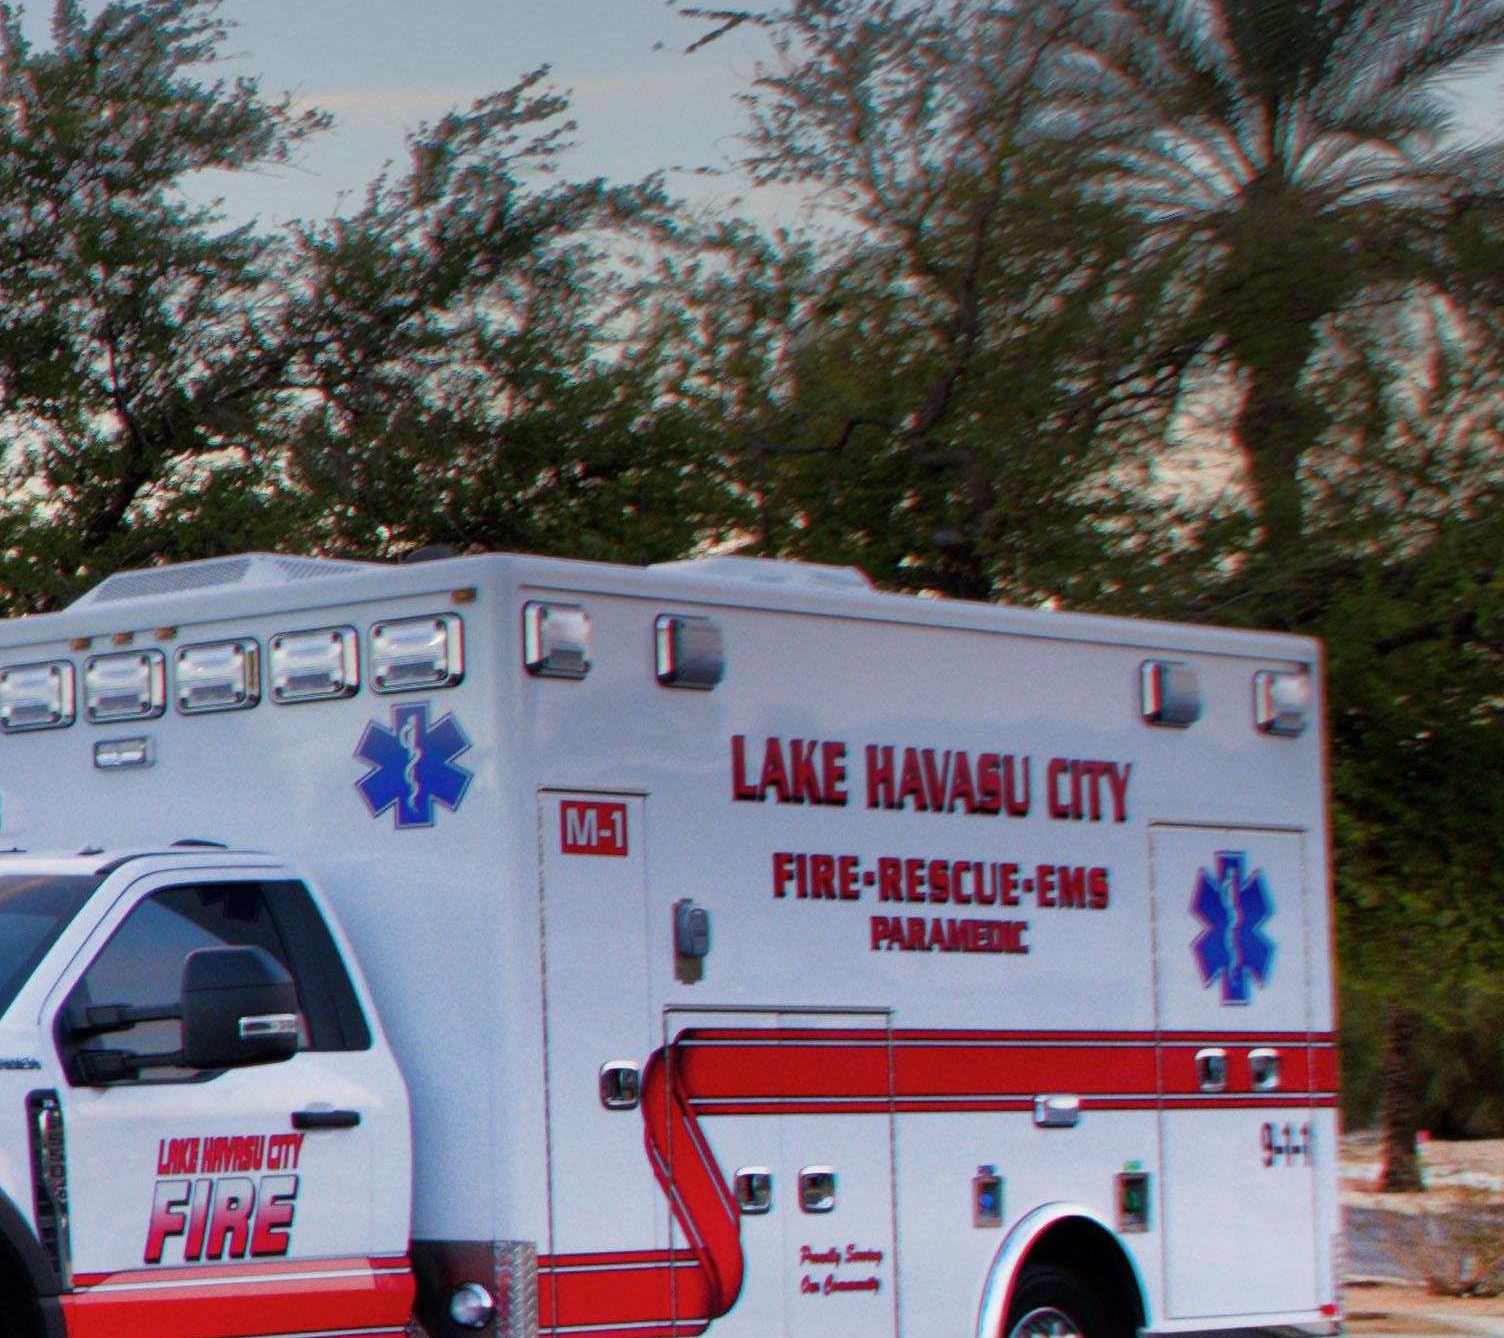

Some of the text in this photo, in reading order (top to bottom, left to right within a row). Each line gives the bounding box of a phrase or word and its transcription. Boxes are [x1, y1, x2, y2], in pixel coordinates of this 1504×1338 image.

[730, 735, 1132, 822] LAKE HAVASU CITY
[566, 807, 624, 849] M-1
[869, 915, 1031, 954] PARAMEDIC
[157, 1133, 305, 1176] LAKE HAVASU CITY
[143, 1174, 302, 1264] FIRE
